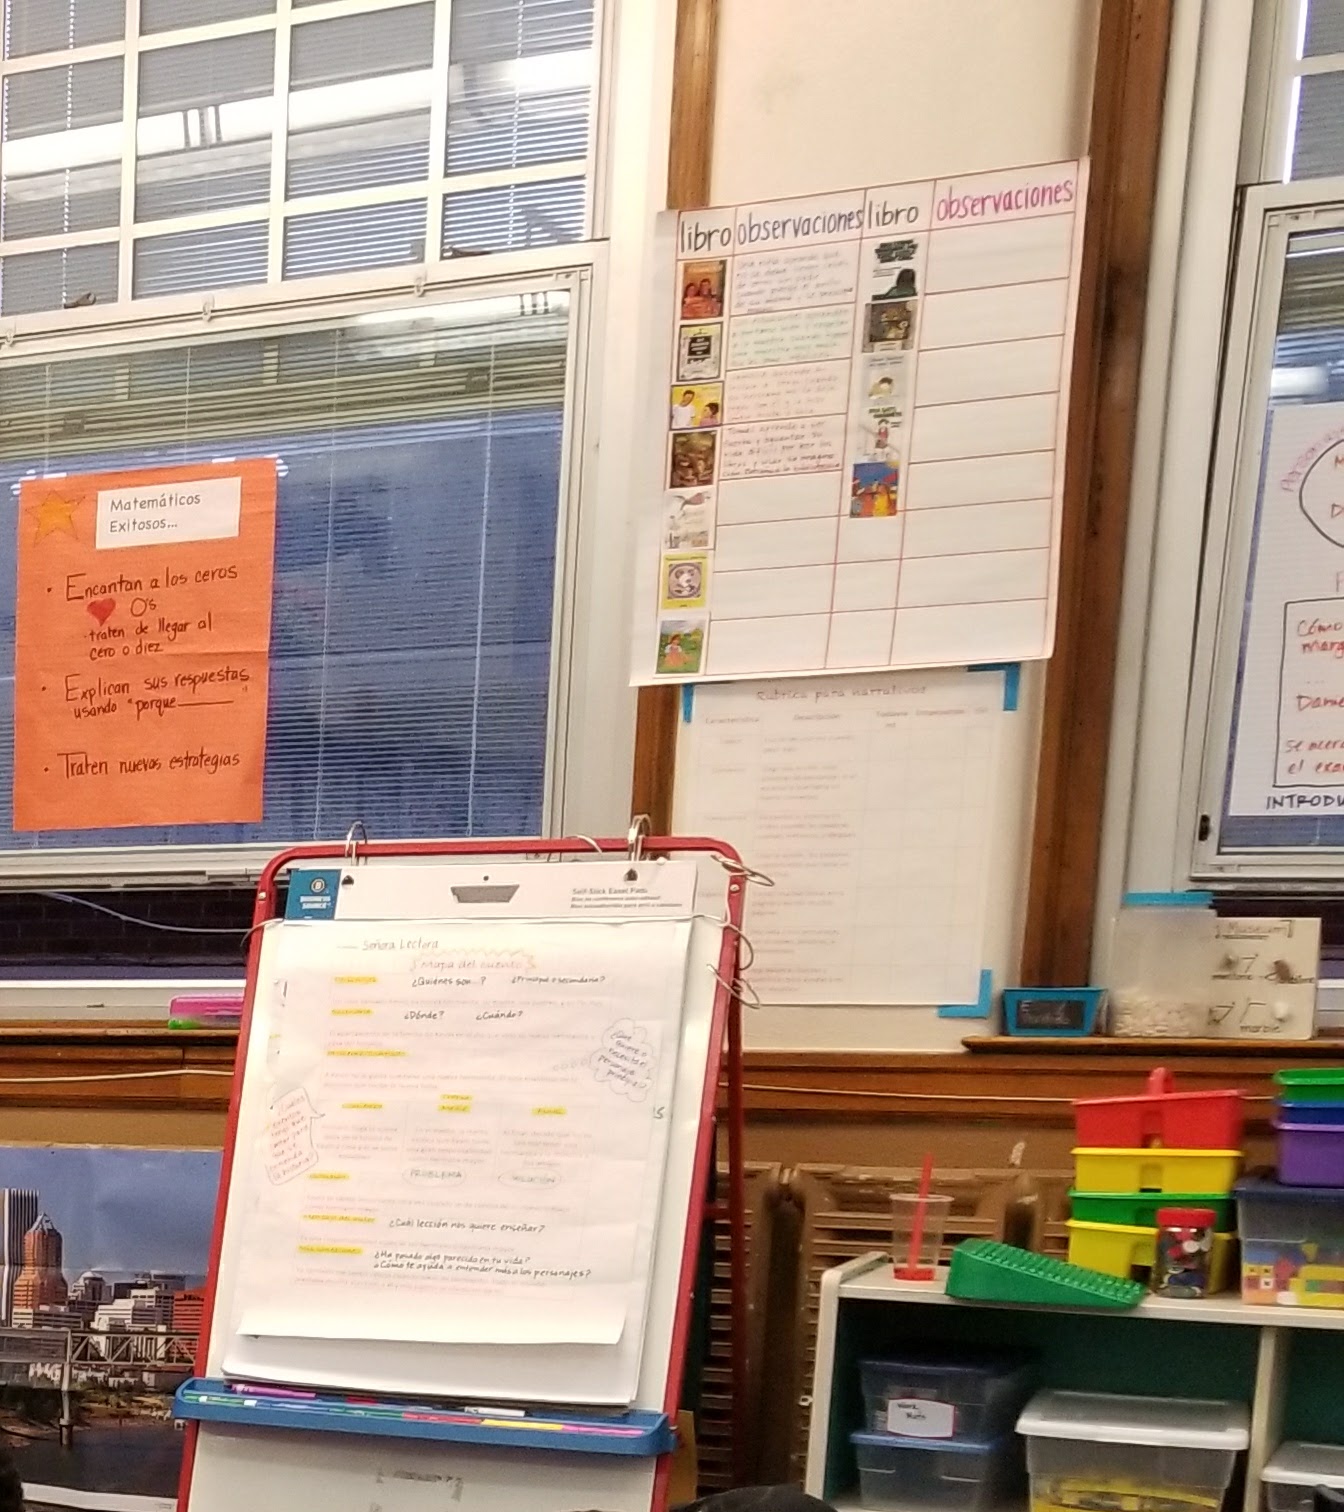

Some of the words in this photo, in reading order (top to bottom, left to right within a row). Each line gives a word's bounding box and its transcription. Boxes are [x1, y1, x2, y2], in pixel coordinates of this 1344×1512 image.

[680, 221, 732, 253] libro
[737, 209, 864, 246] observaciones
[868, 199, 919, 229] libro
[936, 179, 1074, 222] observaciones
[110, 492, 201, 512] Matemáticos
[66, 573, 143, 601] Encantan
[150, 578, 161, 589] a
[165, 566, 188, 588] los
[194, 565, 238, 584] ceros
[135, 620, 149, 635] de
[157, 617, 191, 642] llegar
[198, 611, 213, 632] al
[89, 646, 116, 661] cero
[135, 641, 163, 656] diez
[65, 673, 130, 705] Explican
[144, 677, 168, 690] sus
[174, 666, 250, 694] respuestas
[73, 701, 117, 719] usando
[57, 751, 108, 778] Traten
[168, 746, 240, 774] estrategias
[404, 1009, 445, 1021] ¿Dónde?
[416, 1218, 448, 1229] lección
